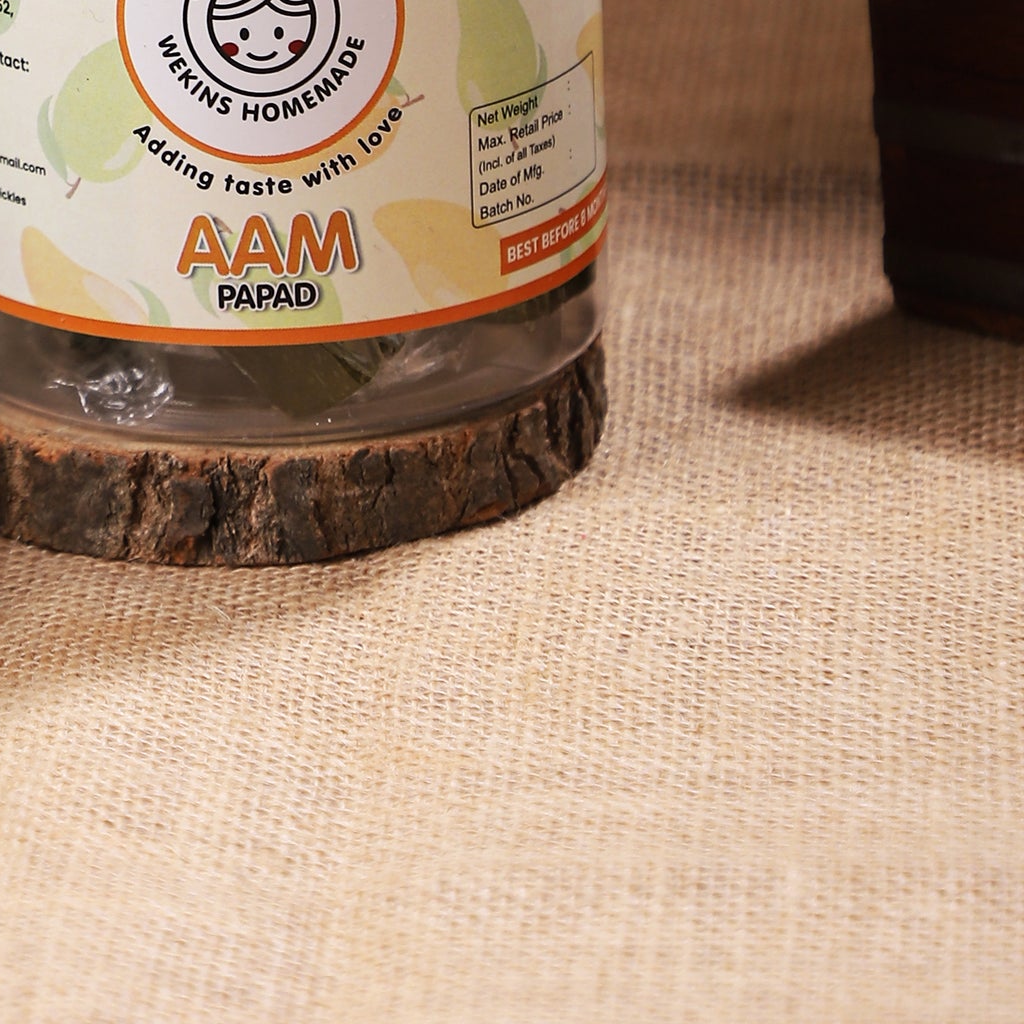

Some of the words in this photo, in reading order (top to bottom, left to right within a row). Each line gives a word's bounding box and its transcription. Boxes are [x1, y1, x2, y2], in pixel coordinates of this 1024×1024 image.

[158, 34, 233, 115] WEKINS
[242, 36, 365, 122] HOMEMADE
[477, 112, 499, 127] Net
[501, 96, 539, 121] Weight
[478, 135, 506, 152] Max.
[509, 119, 539, 142] Retail
[541, 109, 564, 129] Price
[133, 125, 215, 190] Adding
[224, 174, 293, 196] taste
[302, 153, 357, 188] with
[357, 107, 403, 154] love
[506, 151, 515, 165] of
[517, 147, 528, 161] all
[529, 135, 556, 156] Taxes)
[479, 179, 507, 196] Date
[510, 170, 521, 187] of
[523, 164, 545, 181] Mfg.
[480, 199, 513, 220] Batch
[516, 193, 535, 209] No.
[176, 209, 357, 276] AAM
[507, 235, 539, 264] BEST
[541, 213, 580, 250] BEFORE
[217, 281, 318, 310] PAPAD
